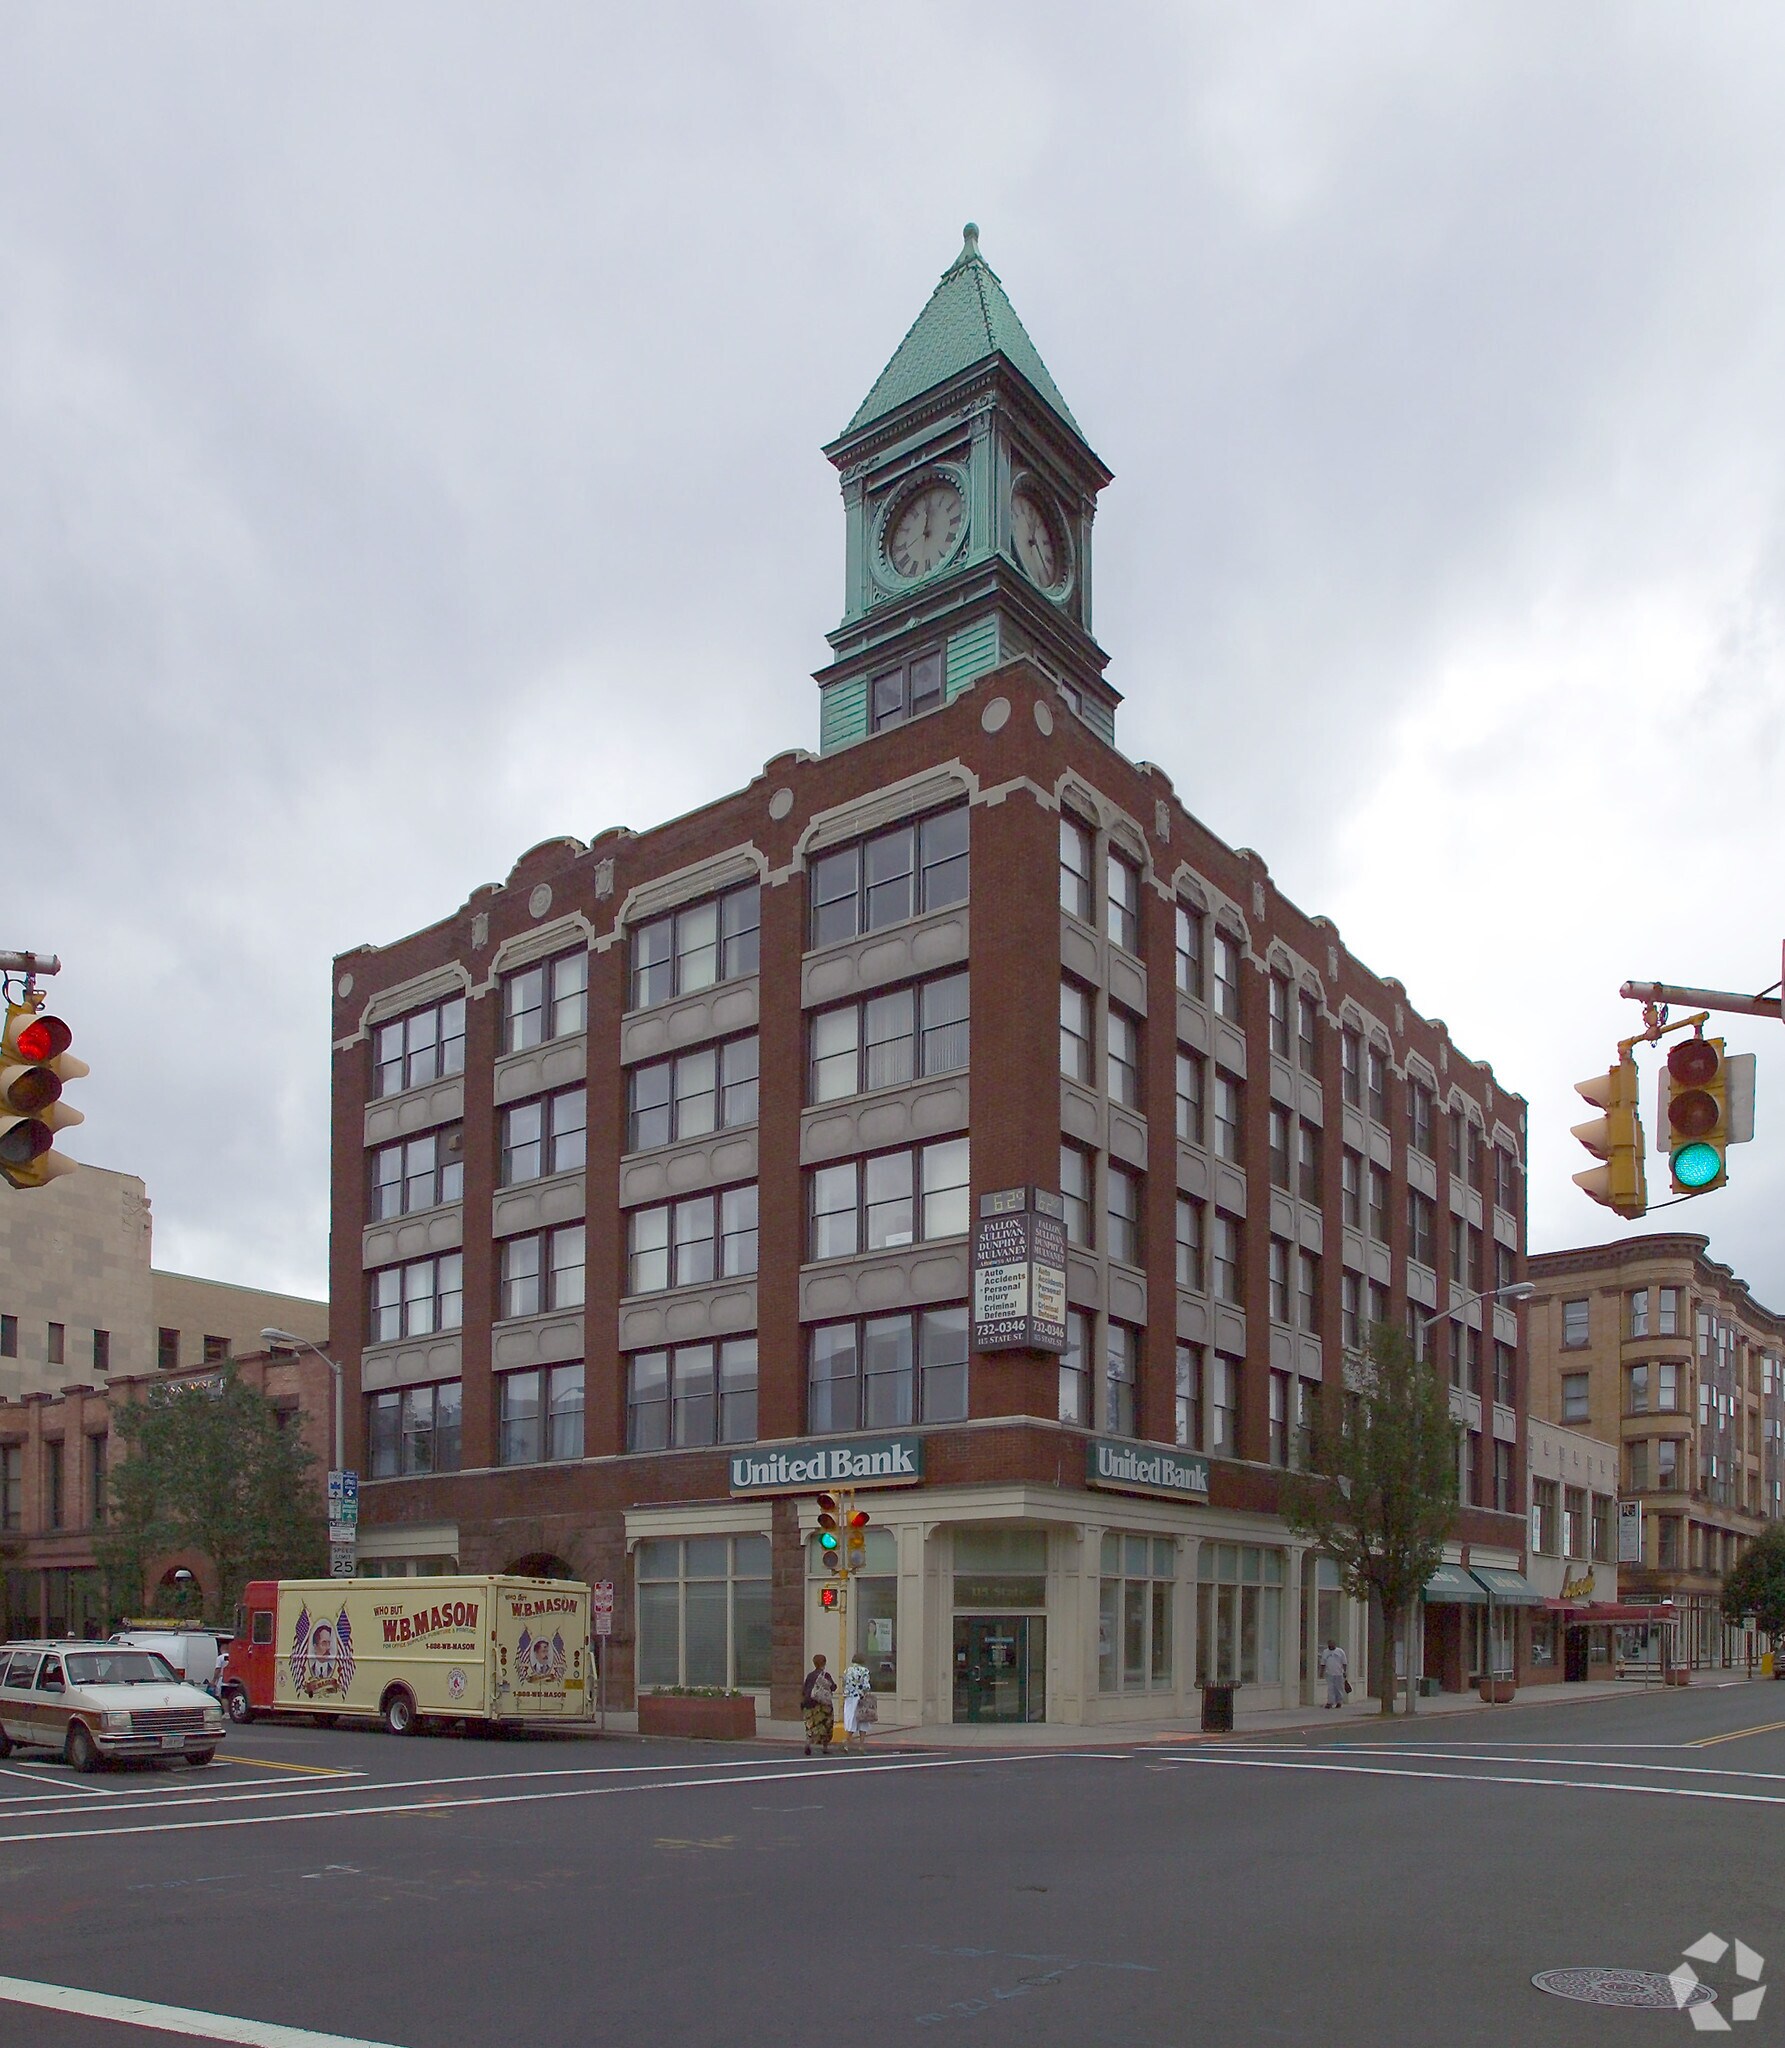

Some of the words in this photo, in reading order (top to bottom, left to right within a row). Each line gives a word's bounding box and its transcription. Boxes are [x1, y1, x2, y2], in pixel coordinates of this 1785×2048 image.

[979, 1238, 1017, 1251] DUNPHY
[1018, 1236, 1025, 1245] &
[977, 1245, 1027, 1260] MULVANEY
[984, 1268, 1004, 1277] Auto
[984, 1273, 1026, 1285] Accidents
[984, 1282, 1021, 1294] Personal
[984, 1293, 1009, 1302] Injury
[984, 1301, 1017, 1312] Criminal
[984, 1310, 1016, 1320] Defense
[976, 1320, 1026, 1336] 732-0346
[1033, 1320, 1064, 1338] 732-0346
[989, 1335, 1012, 1344] STATE
[333, 1560, 353, 1573] 25
[373, 1605, 389, 1616] WHO
[390, 1605, 403, 1615] BUT
